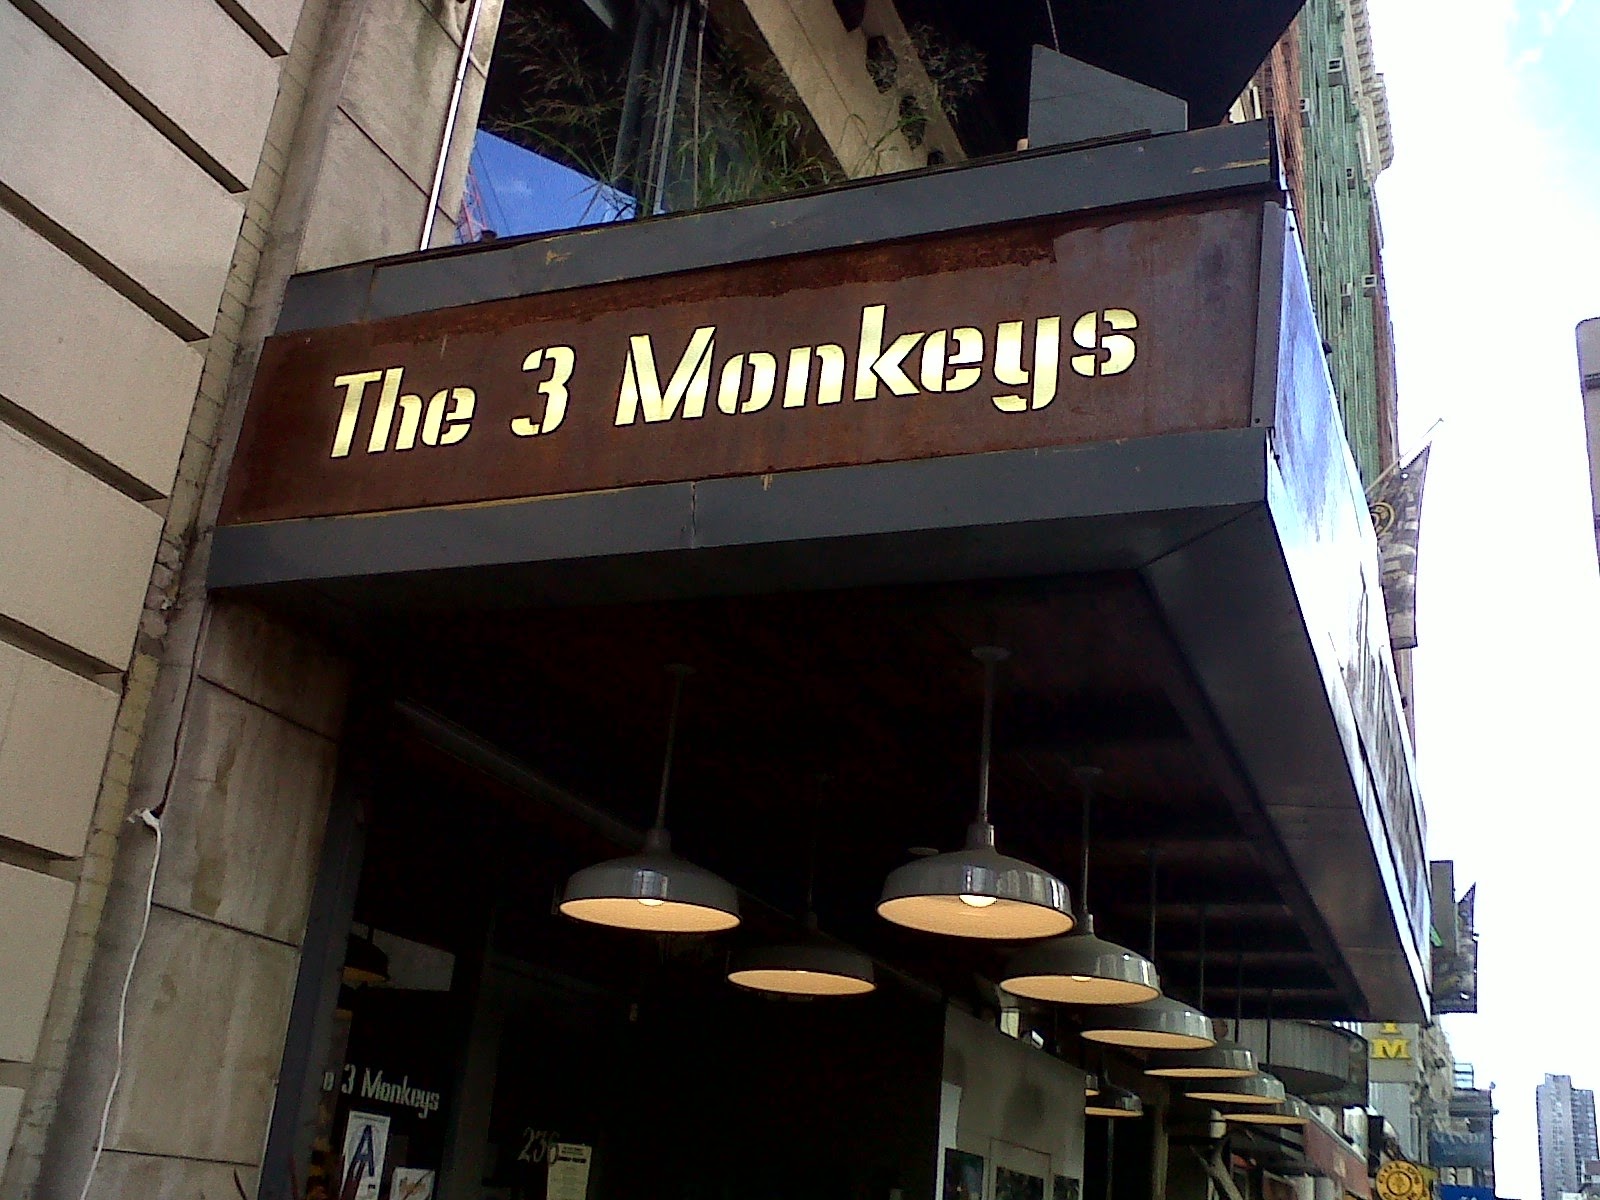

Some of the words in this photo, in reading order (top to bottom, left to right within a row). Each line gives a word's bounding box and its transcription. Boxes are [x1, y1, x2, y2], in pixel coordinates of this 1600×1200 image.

[332, 366, 476, 458] The
[511, 346, 575, 436] 3
[614, 304, 1138, 425] Monkeys
[341, 1063, 356, 1094] 3
[361, 1067, 440, 1119] Monkeys
[350, 1125, 374, 1176] A
